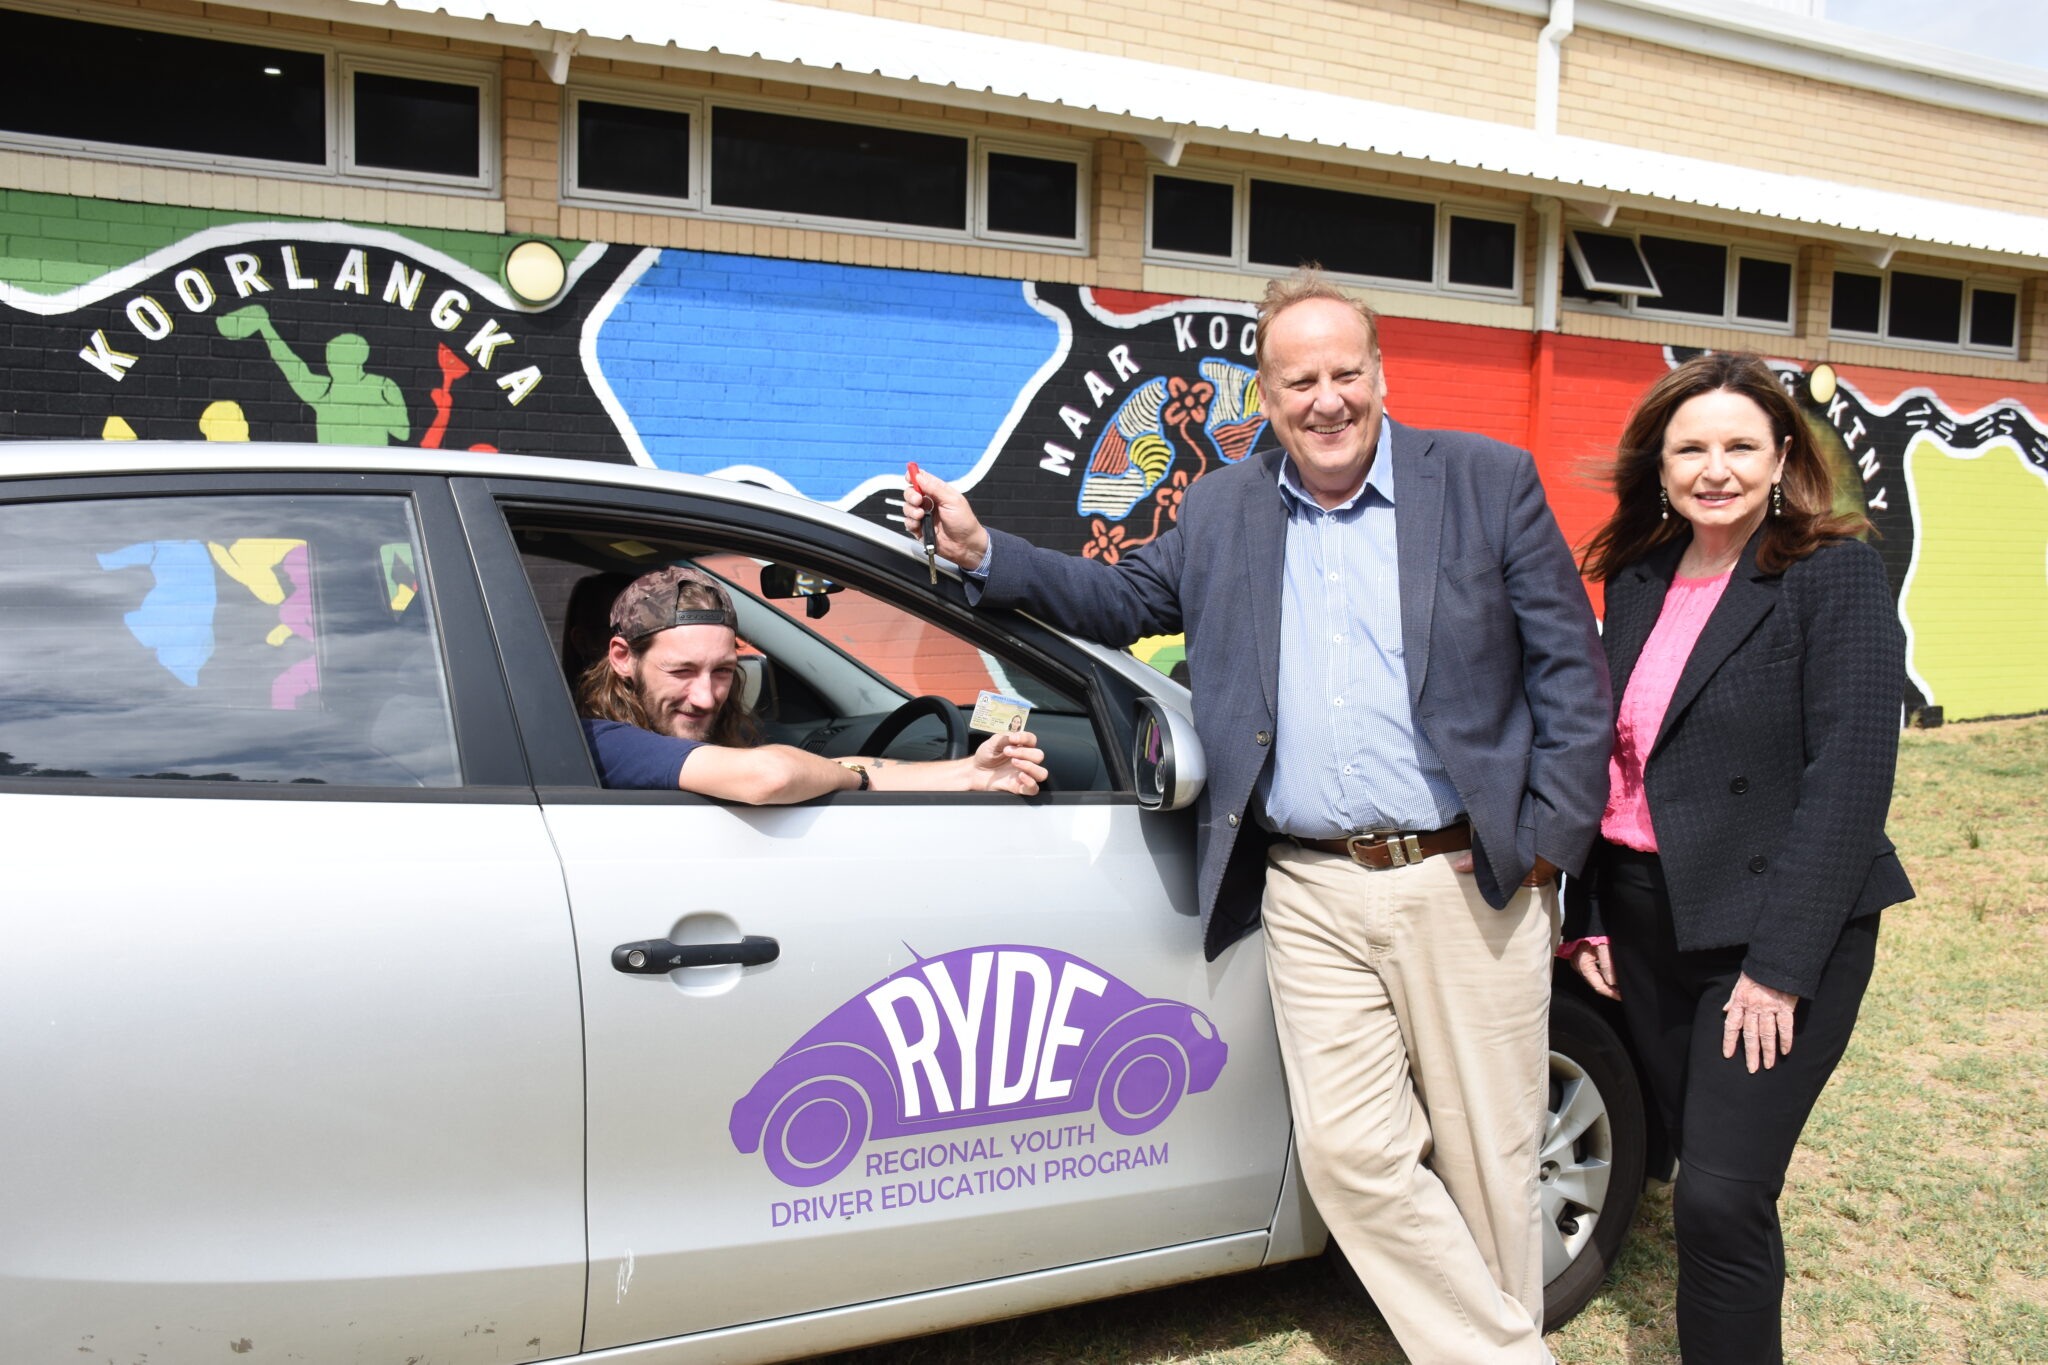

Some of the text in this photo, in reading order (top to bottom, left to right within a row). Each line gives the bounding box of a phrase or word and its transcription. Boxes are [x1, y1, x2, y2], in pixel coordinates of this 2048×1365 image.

[79, 245, 542, 406] KOORLANGKA
[1039, 343, 1142, 477] MAAR
[865, 951, 1109, 1118] RYDE
[771, 1142, 1170, 1228] DRIVER EDUCATION PROGRAM
[865, 1123, 1096, 1178] REGIONAL YOUTH
